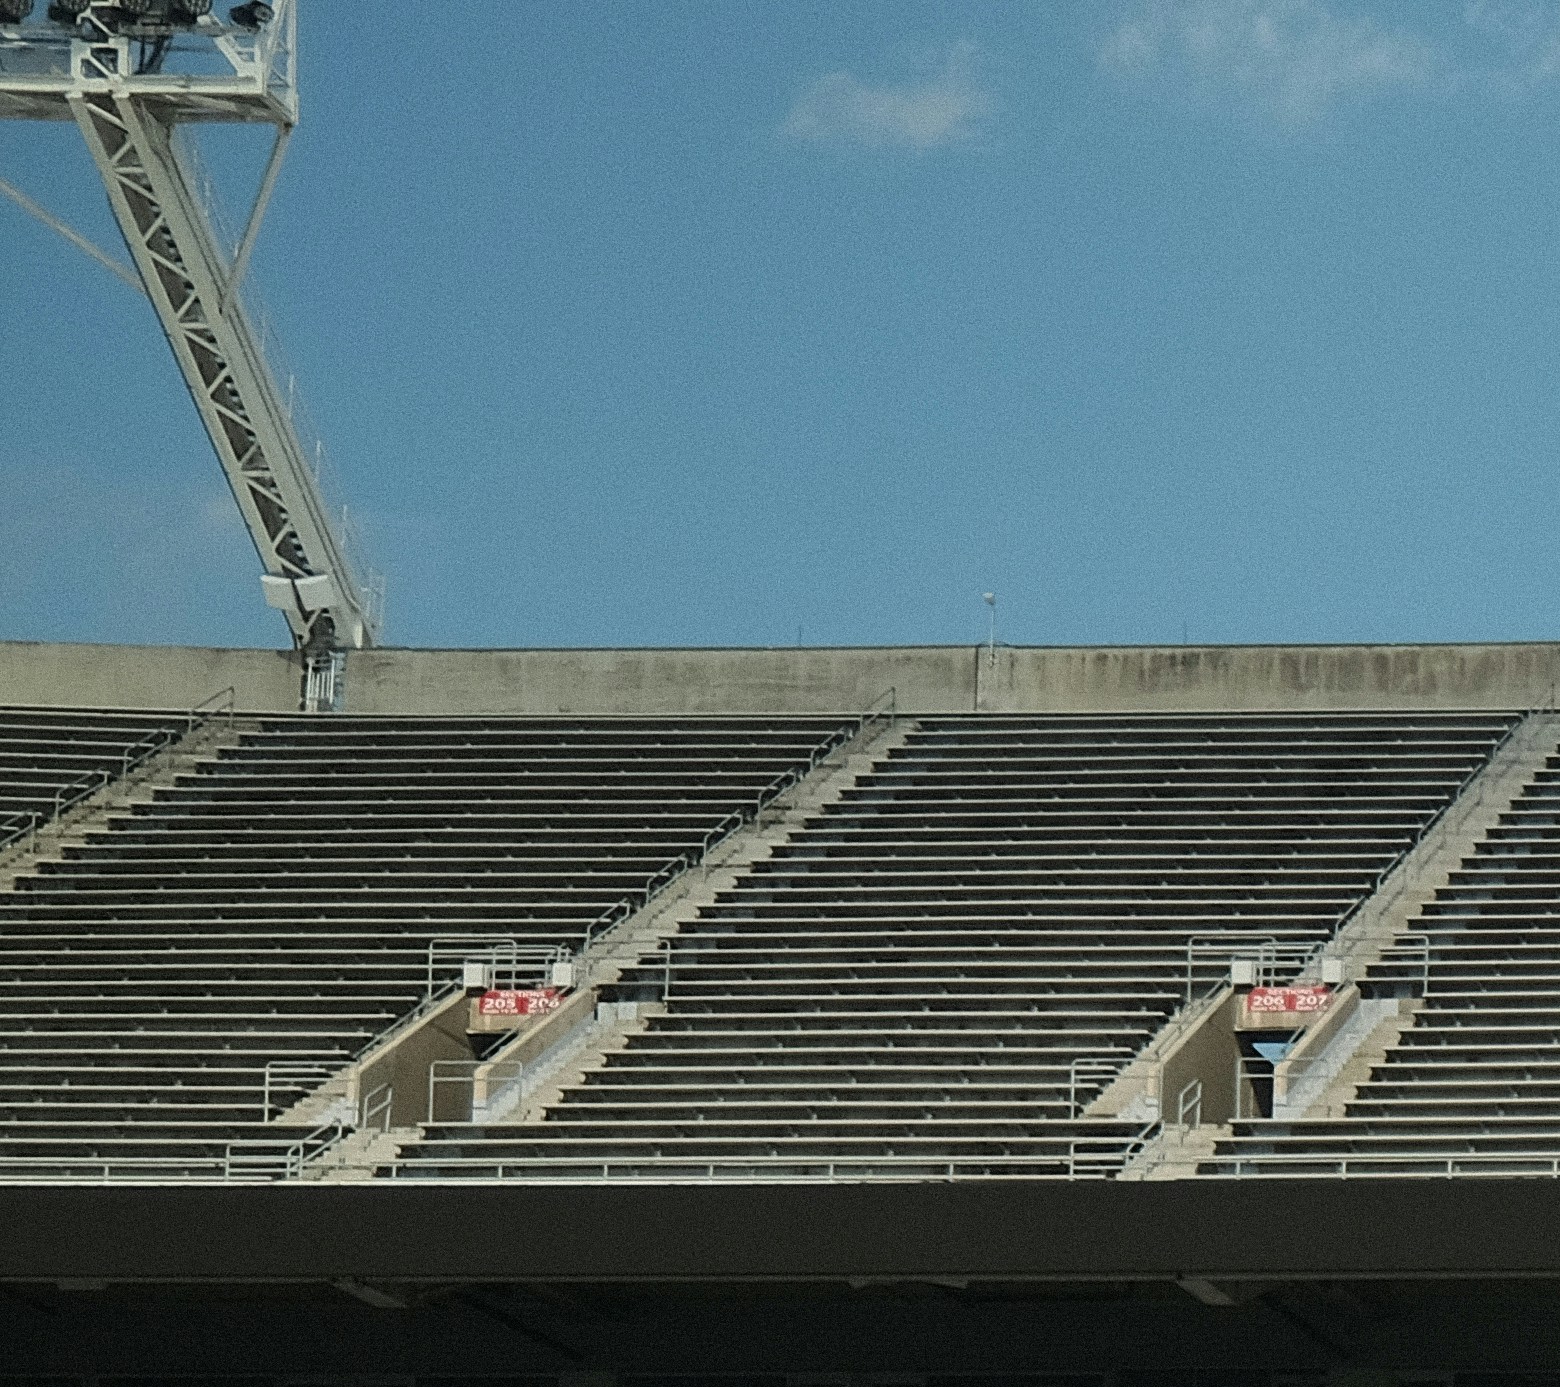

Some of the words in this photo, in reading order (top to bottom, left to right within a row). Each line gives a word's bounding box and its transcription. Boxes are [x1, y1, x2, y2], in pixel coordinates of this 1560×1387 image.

[484, 999, 516, 1008] 205
[1253, 996, 1284, 1005] 206
[1296, 995, 1327, 1005] 207
